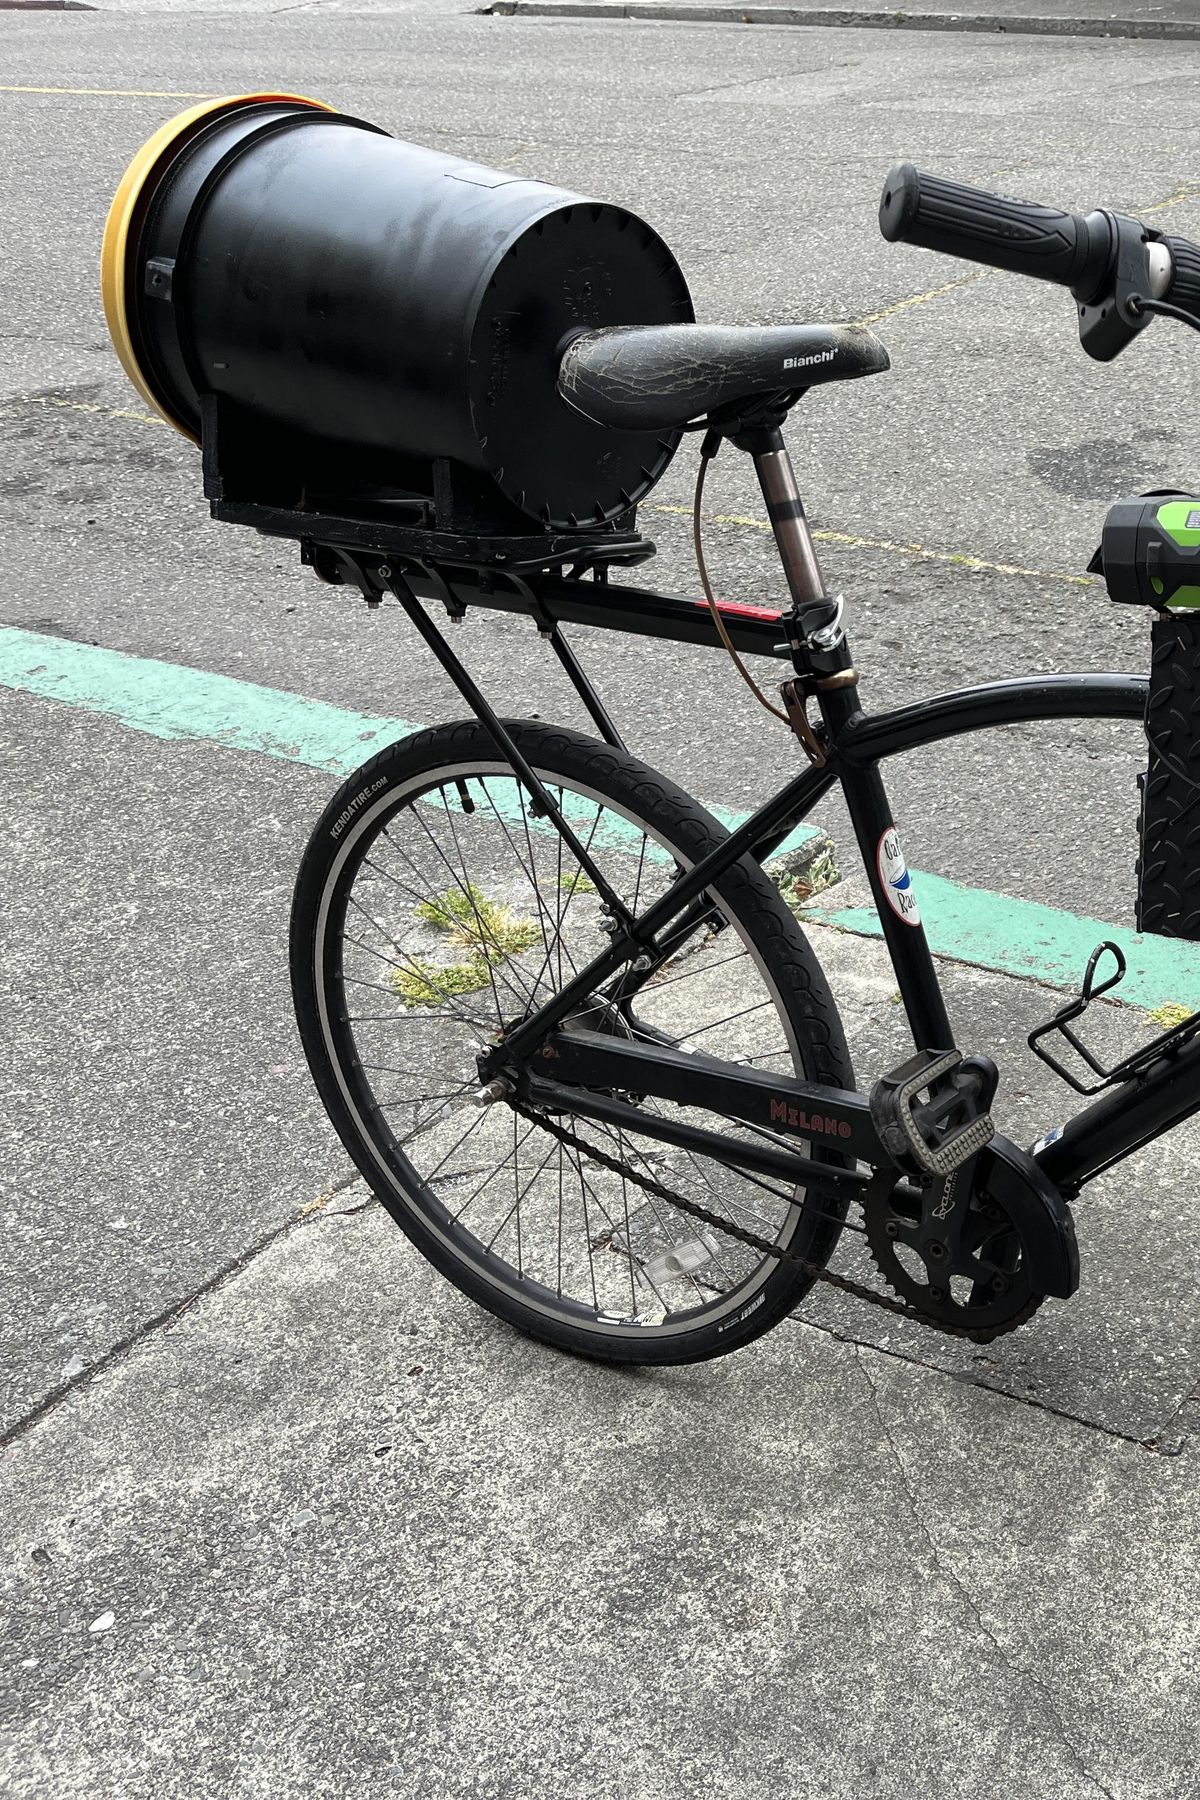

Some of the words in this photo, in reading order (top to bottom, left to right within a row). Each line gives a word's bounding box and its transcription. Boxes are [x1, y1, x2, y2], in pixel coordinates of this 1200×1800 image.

[783, 349, 838, 369] Bianchi
[330, 776, 389, 840] KENDATIRE.COM
[770, 1098, 852, 1139] MILANO
